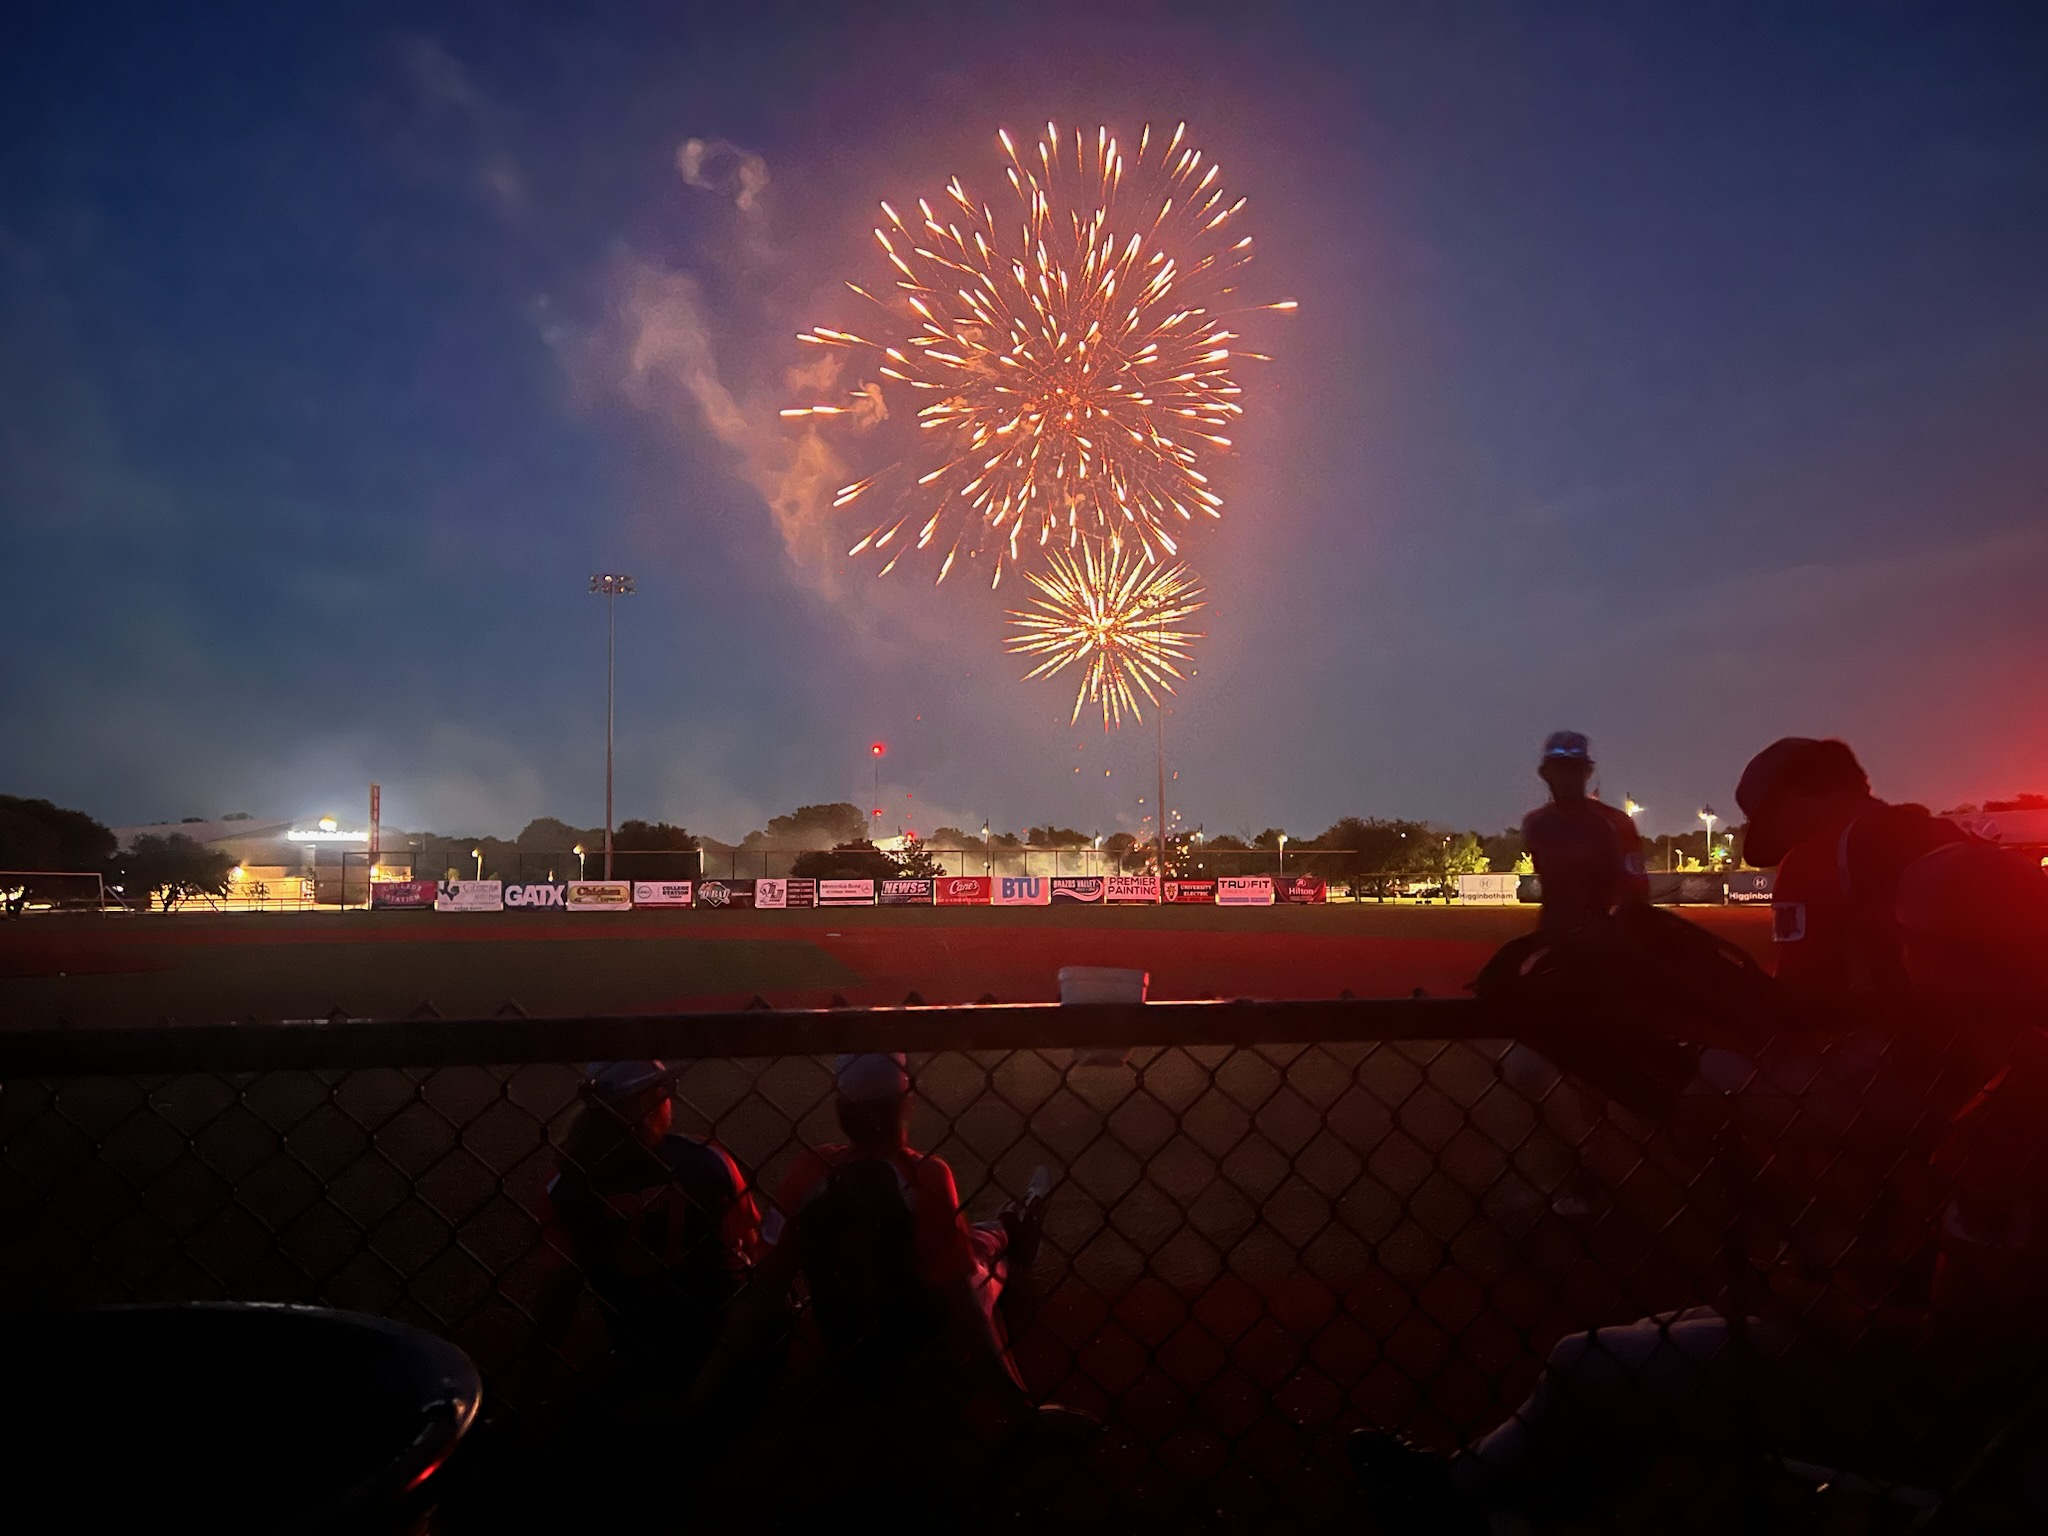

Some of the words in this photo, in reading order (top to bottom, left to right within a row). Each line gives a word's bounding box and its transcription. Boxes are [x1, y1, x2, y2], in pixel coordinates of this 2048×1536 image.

[948, 880, 979, 895] Cane's
[1109, 877, 1156, 886] PREMIER
[883, 882, 918, 894] NEWS
[1002, 877, 1040, 899] BTU
[1288, 887, 1314, 895] Hilton
[504, 884, 566, 907] GATX
[1729, 892, 1773, 901] Higginbot
